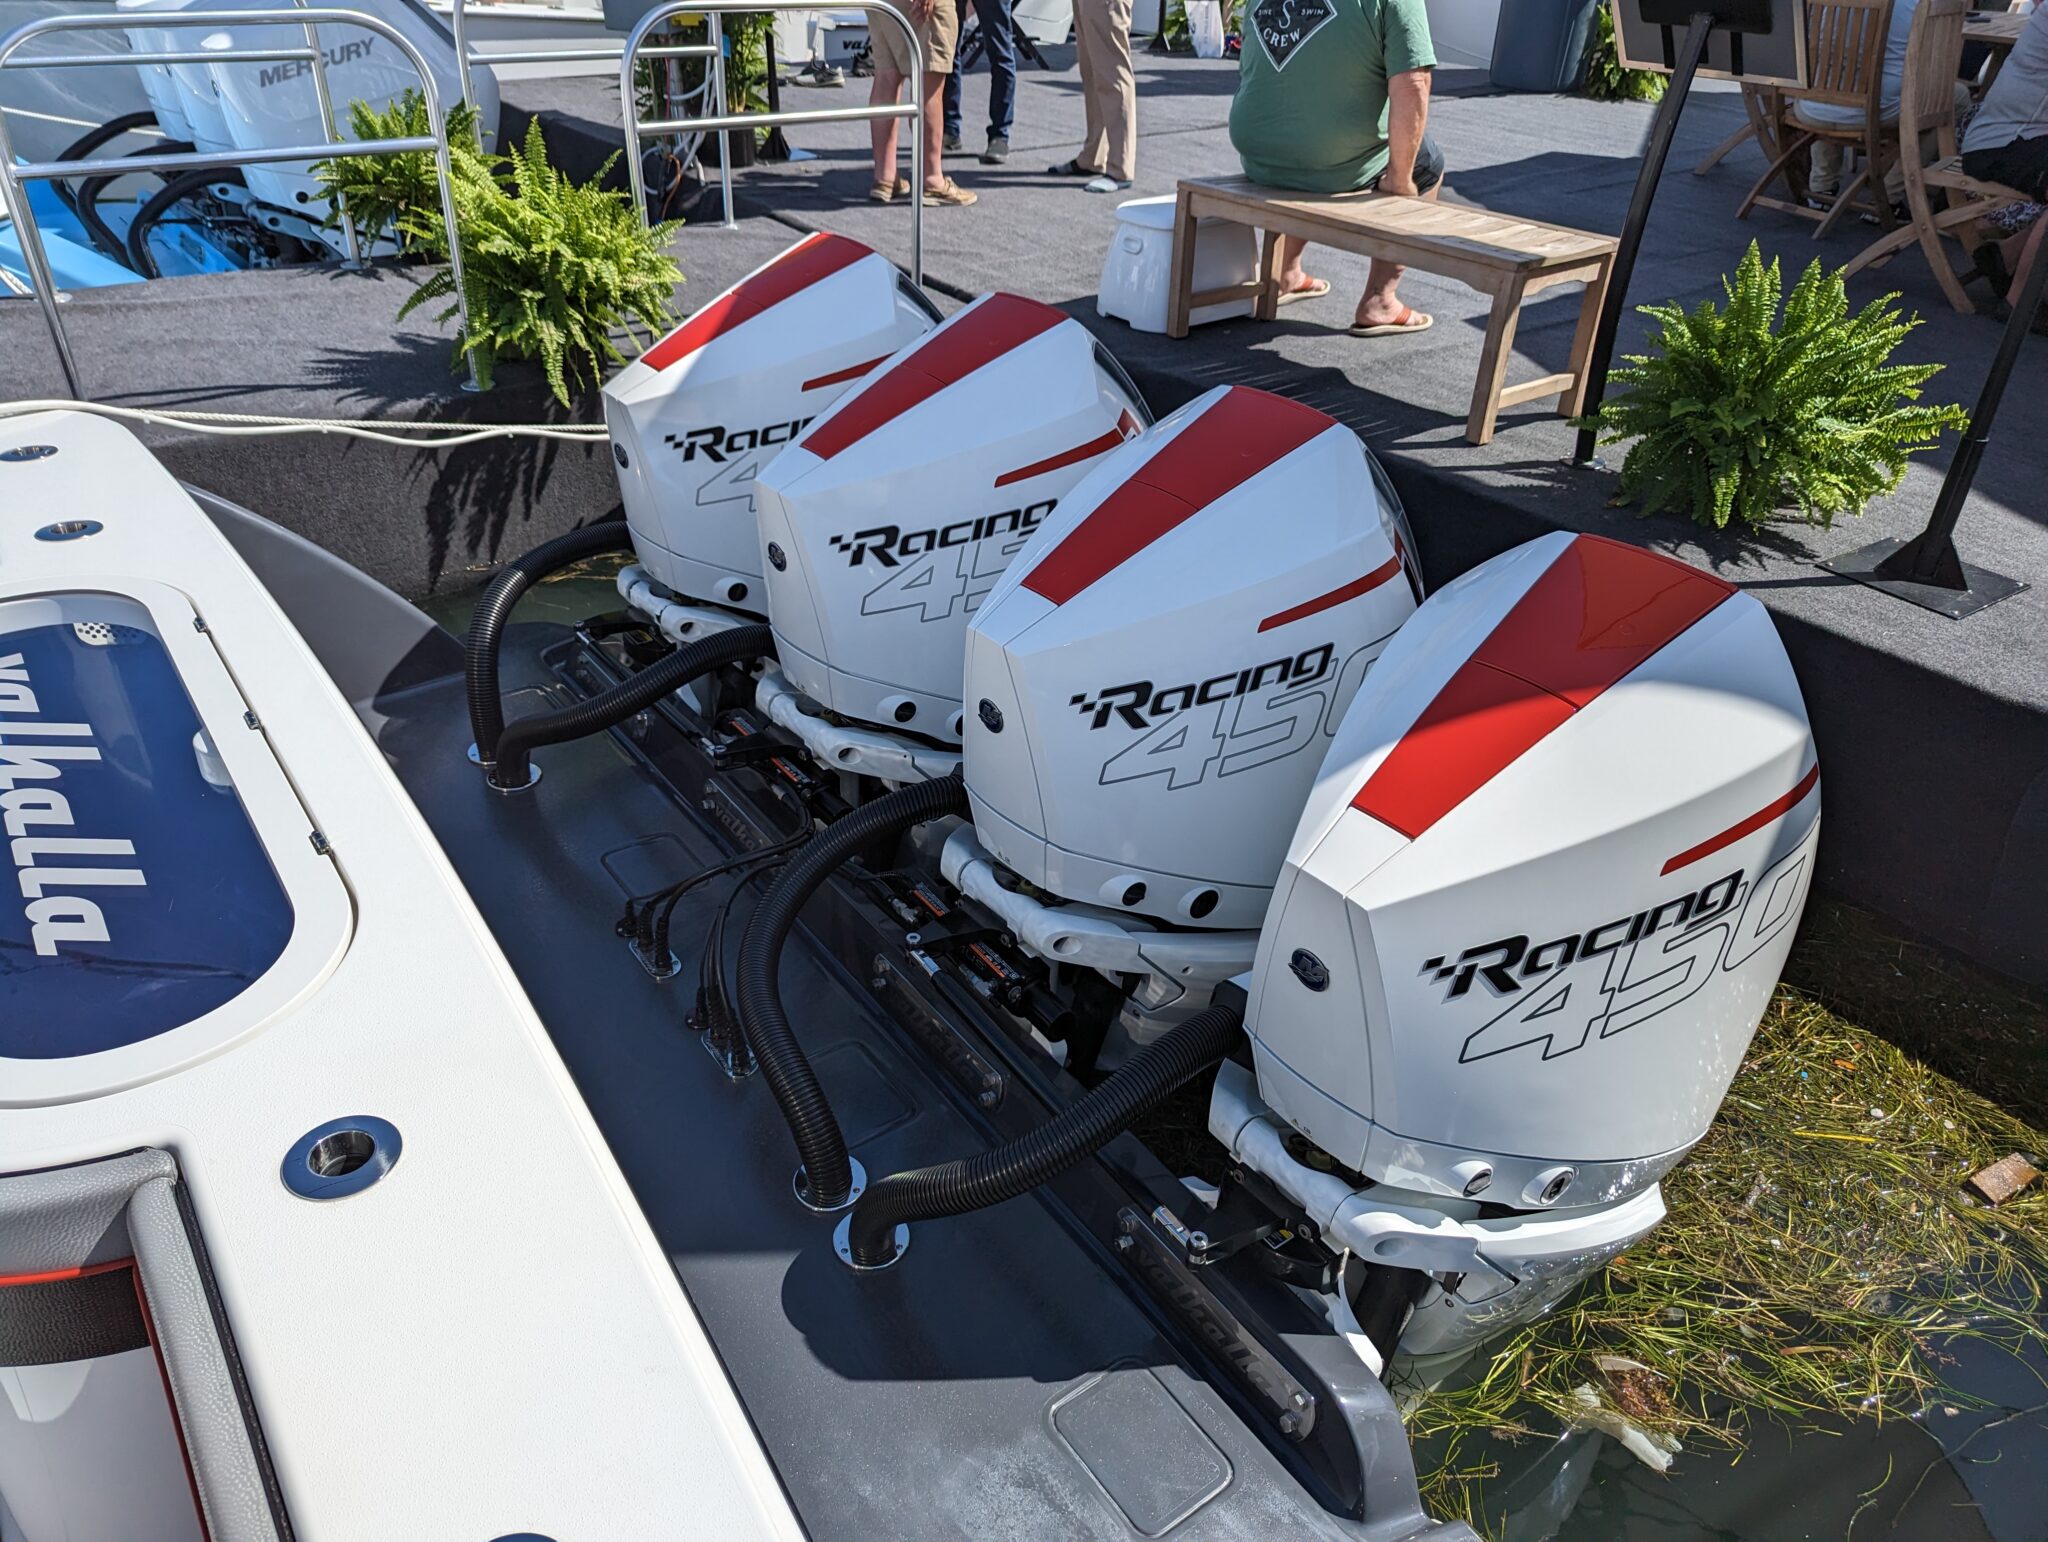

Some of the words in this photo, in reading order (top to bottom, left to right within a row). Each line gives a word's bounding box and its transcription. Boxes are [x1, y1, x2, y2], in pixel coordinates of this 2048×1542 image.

[1263, 27, 1300, 48] CREW
[1301, 8, 1325, 16] SWIM
[682, 415, 817, 463] Raci
[1089, 641, 1335, 731] Racing
[1440, 868, 1745, 1005] Racing
[1457, 815, 1820, 1064] 450
